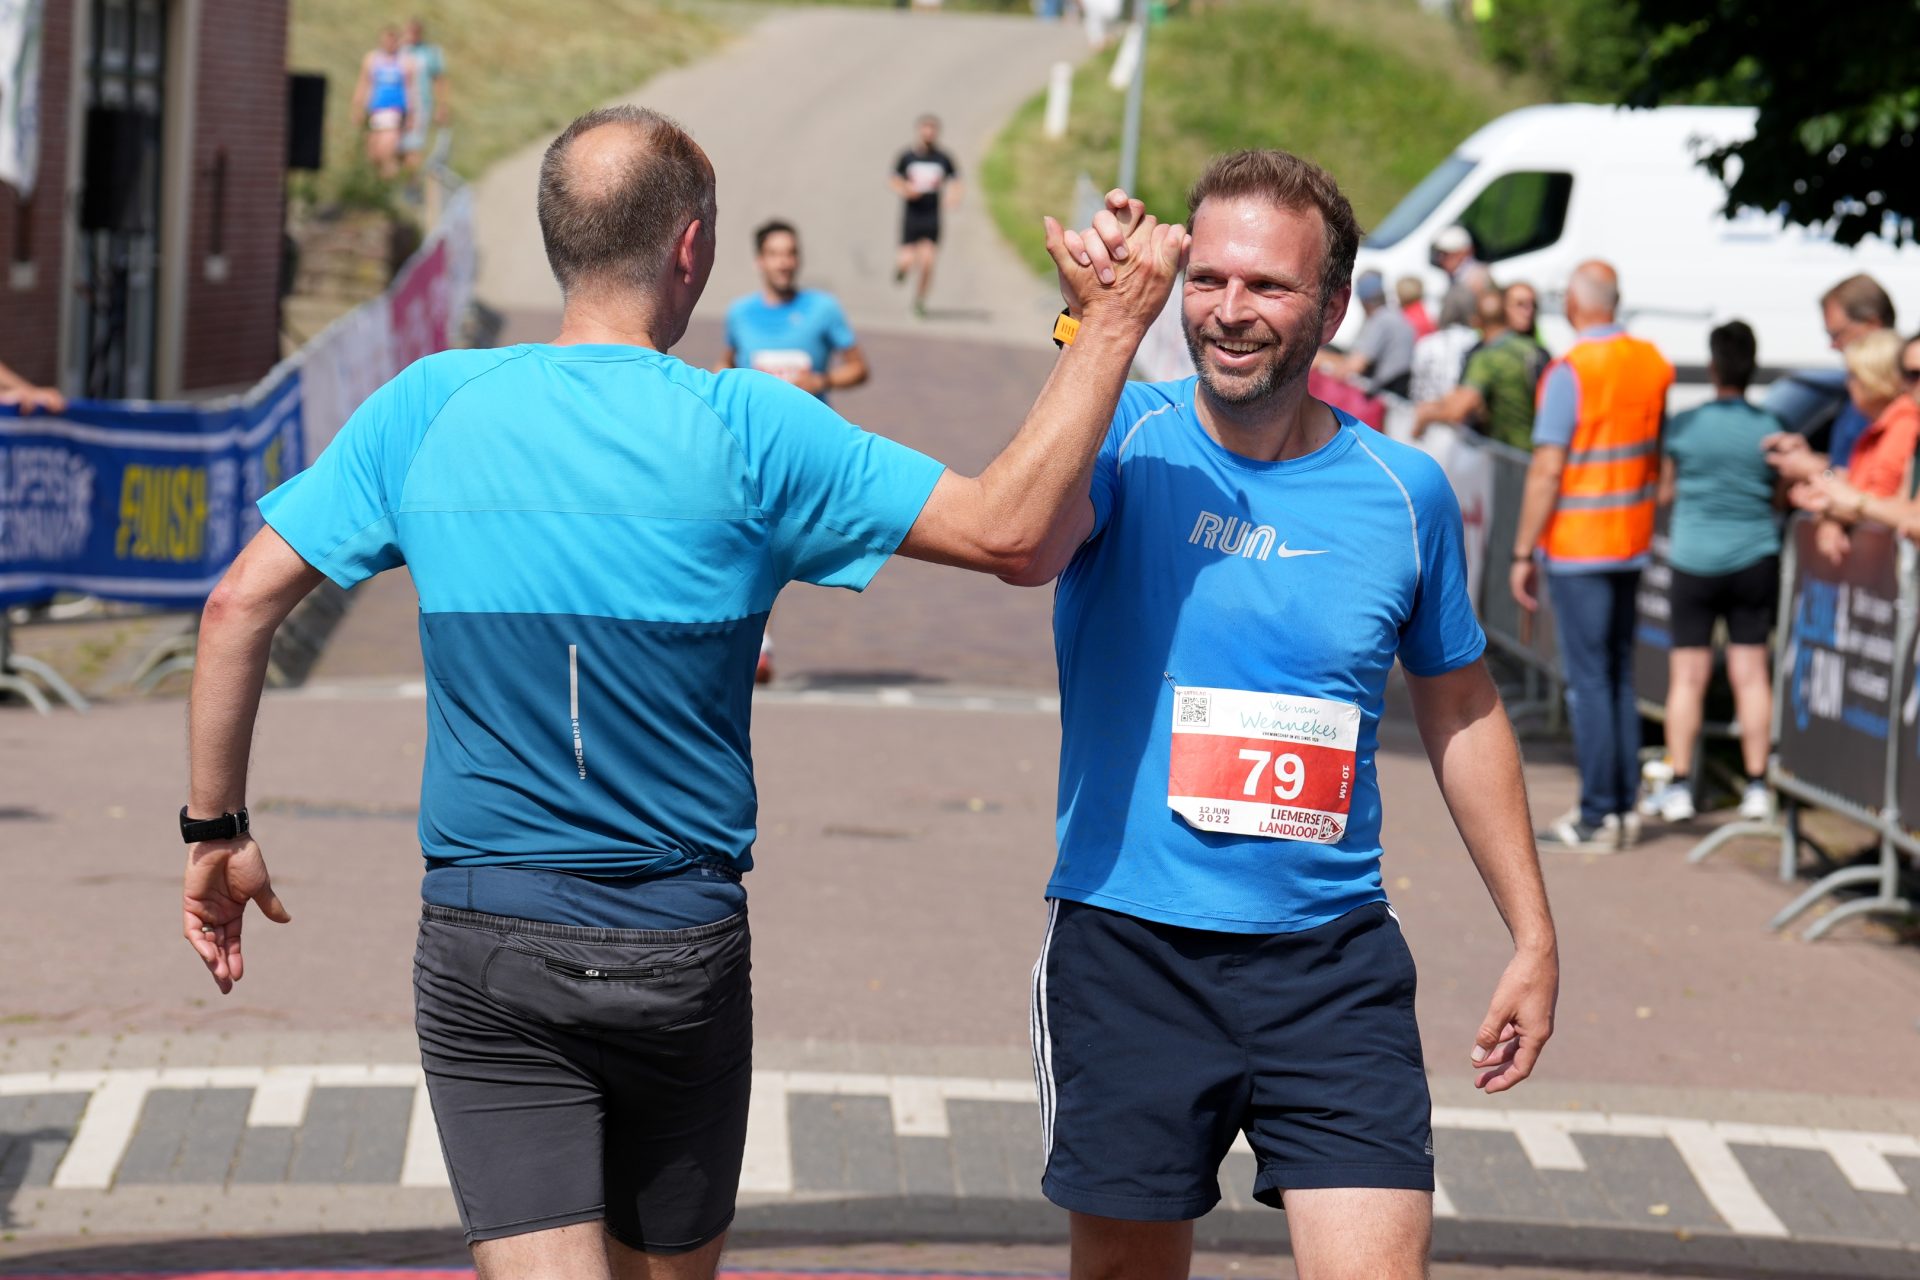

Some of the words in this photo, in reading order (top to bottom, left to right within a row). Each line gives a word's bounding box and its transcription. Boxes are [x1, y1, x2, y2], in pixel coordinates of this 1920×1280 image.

[115, 464, 208, 562] FINISH
[1188, 510, 1277, 561] RUN
[1270, 700, 1291, 713] Vis
[1294, 704, 1320, 716] van
[1240, 712, 1337, 740] Wennekes
[1238, 748, 1305, 800] 79
[1341, 764, 1350, 780] 10
[1338, 782, 1348, 799] KM
[1198, 813, 1230, 825] 2022
[1199, 806, 1210, 814] 12
[1212, 807, 1230, 816] JUNI
[1271, 808, 1322, 826] LIEMERSE
[1258, 820, 1319, 839] LANDLOOP
